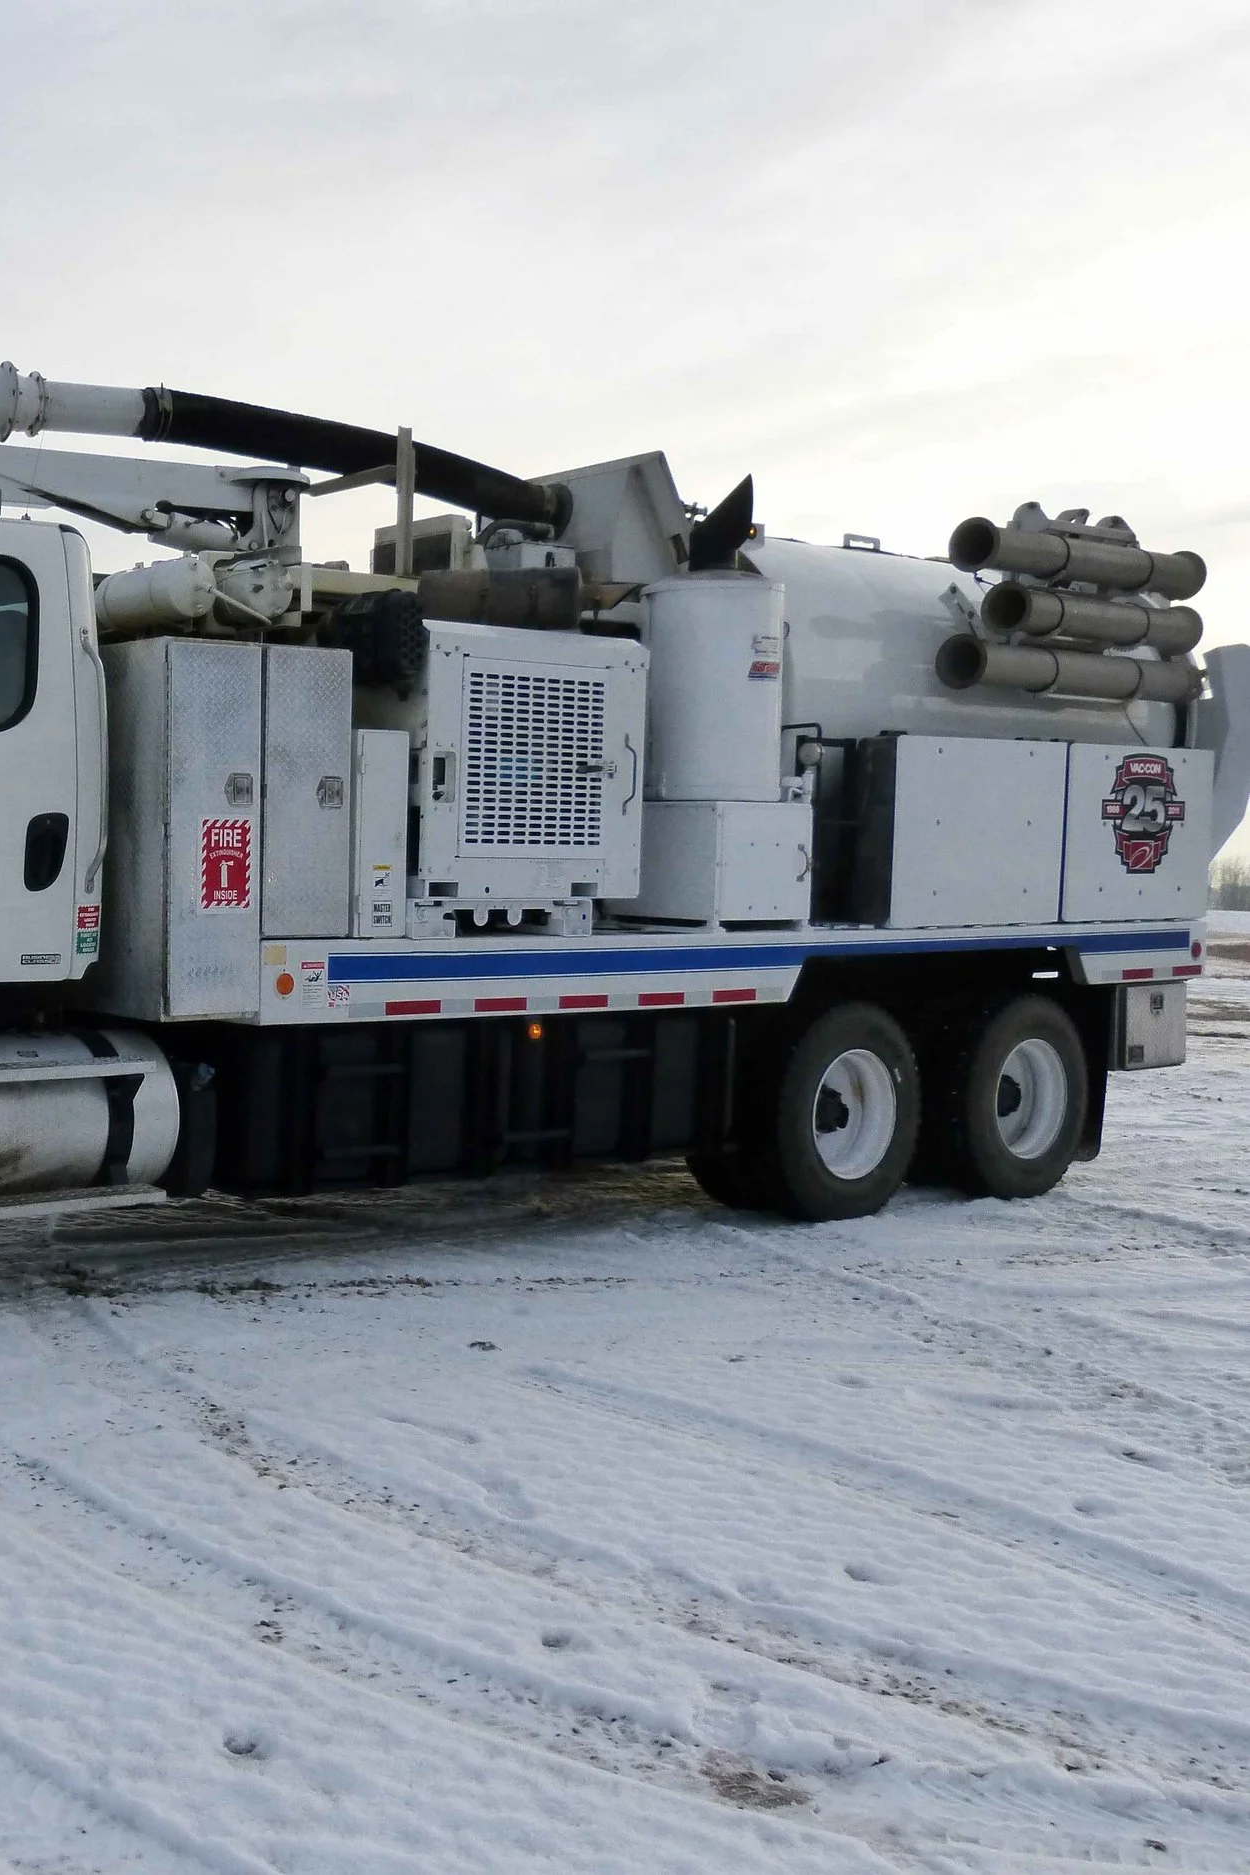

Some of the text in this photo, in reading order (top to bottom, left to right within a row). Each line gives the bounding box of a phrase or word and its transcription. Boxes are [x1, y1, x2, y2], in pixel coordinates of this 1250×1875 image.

[1121, 784, 1165, 833] 25
[211, 828, 242, 848] FIRE
[209, 849, 244, 859] EXTINGUISHER
[213, 890, 238, 900] INSIDE
[373, 903, 391, 912] MASTER
[373, 915, 391, 924] SWITCH
[329, 987, 349, 1001] USA
